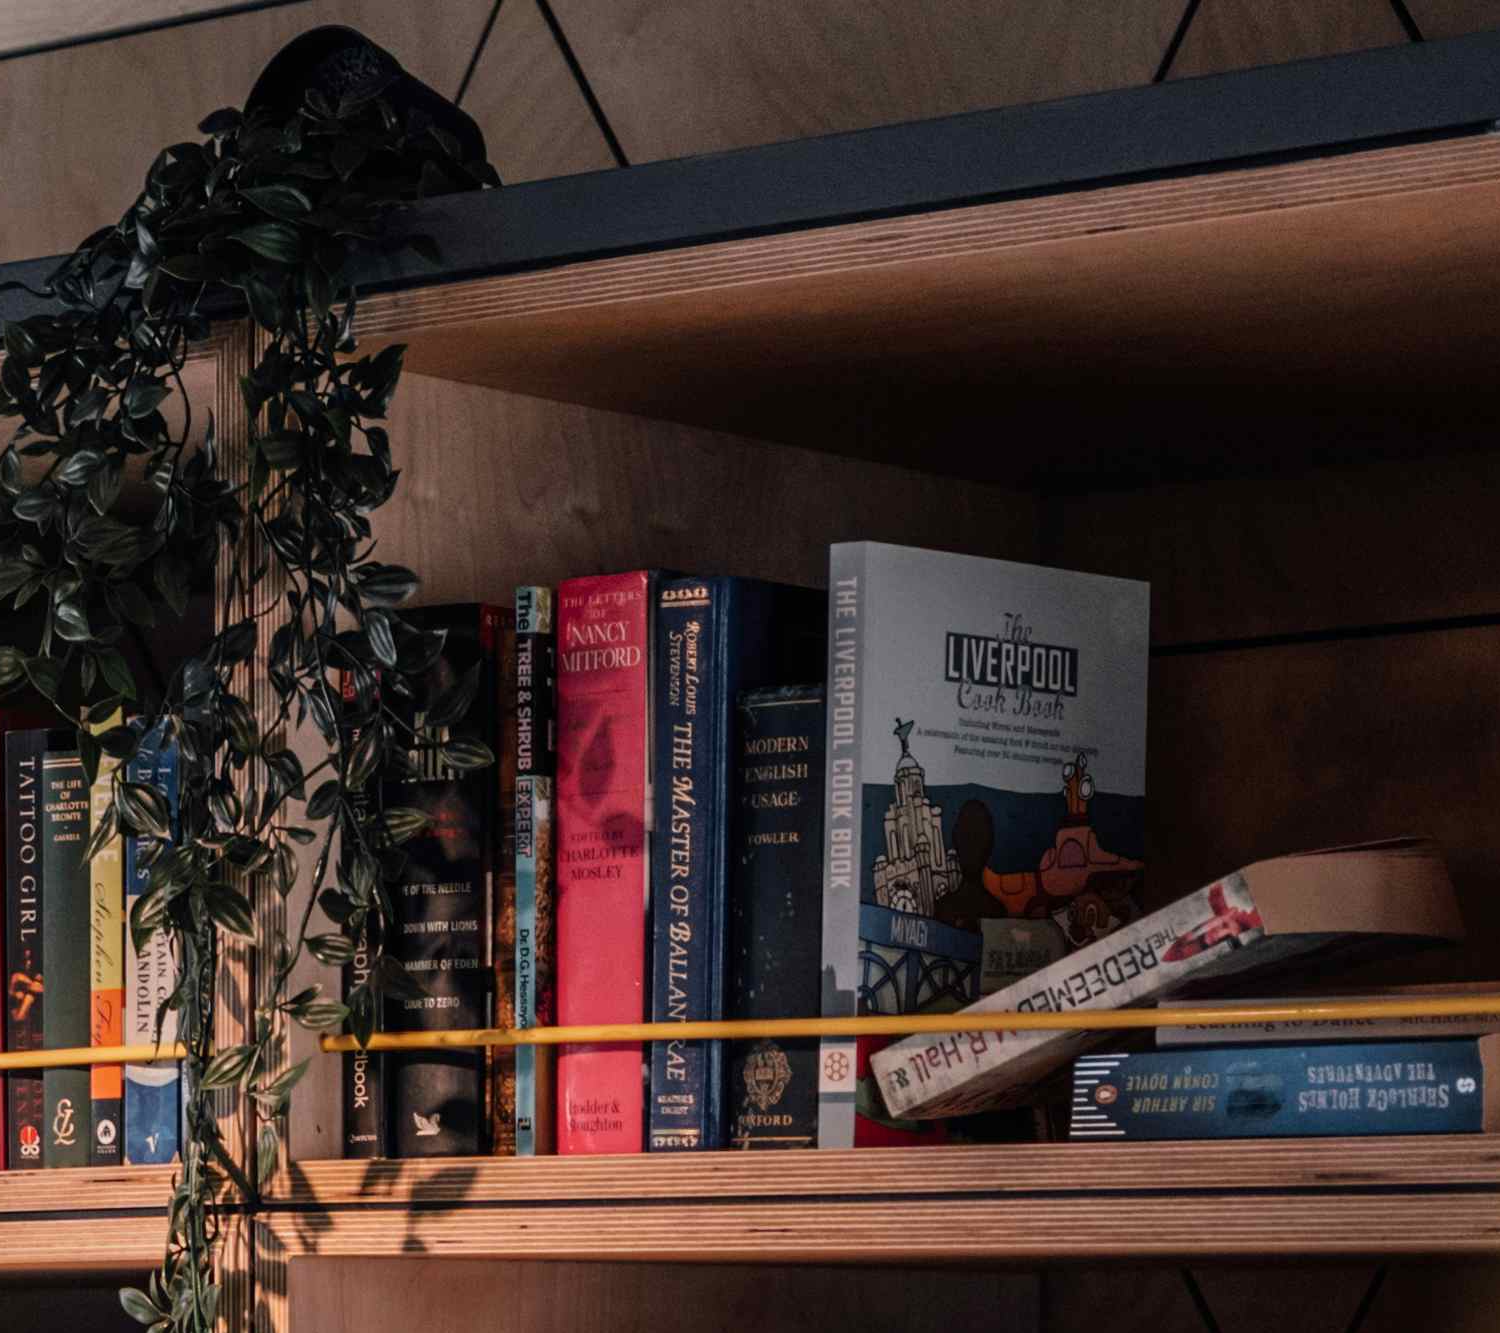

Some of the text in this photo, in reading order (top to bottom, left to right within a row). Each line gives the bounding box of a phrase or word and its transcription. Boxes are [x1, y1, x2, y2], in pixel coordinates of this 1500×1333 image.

[561, 646, 642, 672] MITFORD
[572, 622, 629, 646] NANCY
[949, 636, 1076, 693] LIVERPOOL
[516, 591, 533, 858] The TREE SHRUB EXPERT
[745, 737, 809, 755] MODERN
[830, 576, 857, 889] THE LIVERPOOL COOK BOOK
[745, 763, 808, 783] ENGLISH
[669, 722, 695, 917] THE MASTER OF
[20, 759, 37, 941] TATTOO GIRL
